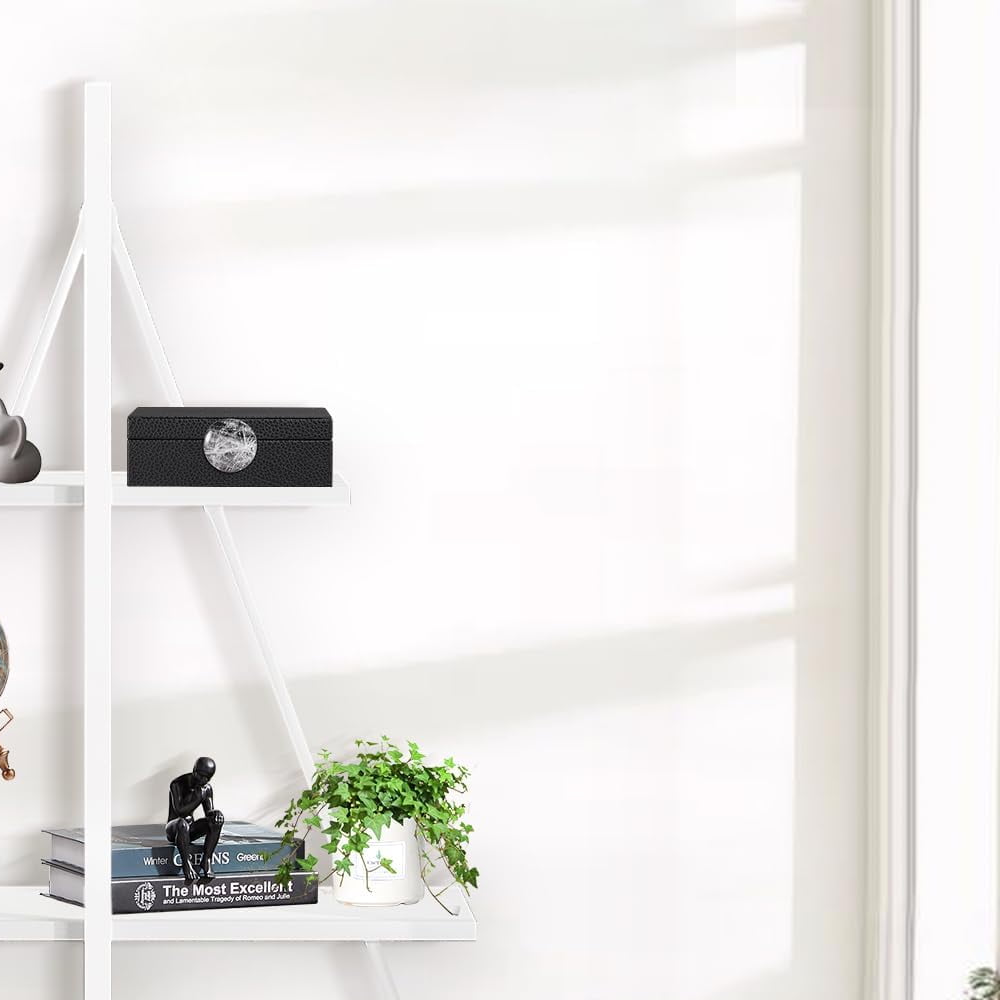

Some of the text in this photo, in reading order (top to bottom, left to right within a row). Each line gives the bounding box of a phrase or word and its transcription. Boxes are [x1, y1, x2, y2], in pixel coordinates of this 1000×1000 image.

[144, 856, 168, 865] Winter
[163, 885, 188, 896] The
[193, 884, 226, 896] Most
